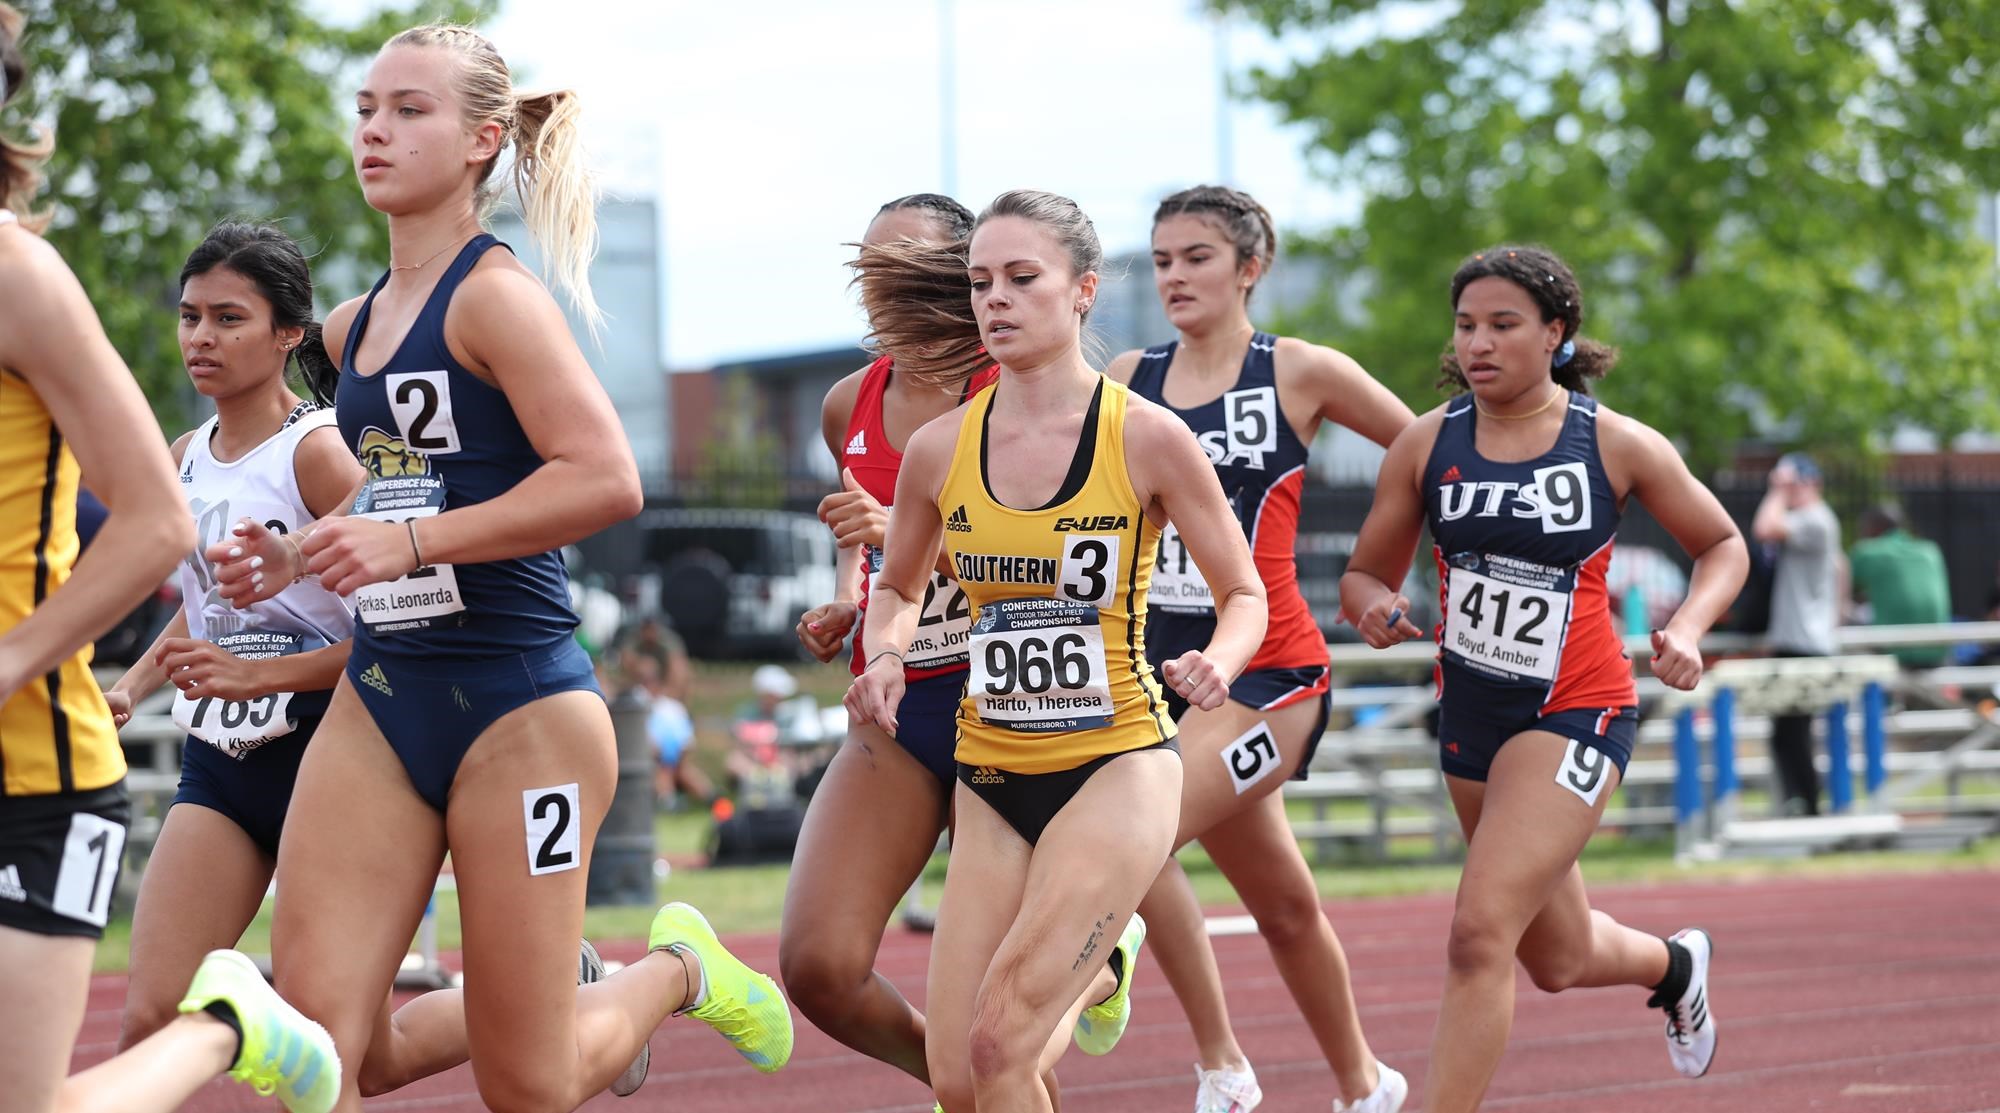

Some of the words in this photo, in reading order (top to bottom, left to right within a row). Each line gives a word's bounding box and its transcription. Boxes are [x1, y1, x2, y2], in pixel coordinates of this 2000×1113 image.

[396, 379, 449, 449] 2
[1234, 393, 1267, 446] 5
[372, 479, 420, 491] CONFERENCE
[420, 479, 441, 489] USA
[1544, 469, 1584, 526] 9
[375, 497, 427, 509] CHAMPIONSHIPS
[946, 522, 972, 533] adidas
[954, 551, 1058, 586] SOUTHERN
[1063, 540, 1109, 602] 3
[1484, 553, 1544, 572] CONFERENCE
[1545, 566, 1565, 577] USA
[1489, 570, 1554, 590] CHAMPIONSHIPS
[359, 595, 390, 613] Farkas,
[390, 588, 453, 610] Leonarda
[1002, 600, 1065, 612] CONFERENCE
[1006, 611, 1036, 620] OUTDOOR
[1037, 610, 1058, 618] TRACK
[1064, 608, 1084, 616] FIELD
[1011, 616, 1082, 629] CHAMPIONSHIPS
[1460, 582, 1549, 646] 412
[218, 634, 270, 646] CONFERENCE
[272, 634, 293, 644] USA
[1457, 631, 1488, 657] Boyd,
[1491, 646, 1539, 668] Amber
[985, 633, 1091, 696] 966
[360, 673, 393, 697] adidas
[1034, 696, 1102, 710] Theresa
[1231, 731, 1276, 780] 5
[1567, 742, 1605, 793] 9
[971, 774, 1005, 784] adidas
[532, 792, 572, 868] 2
[88, 829, 109, 913] 1
